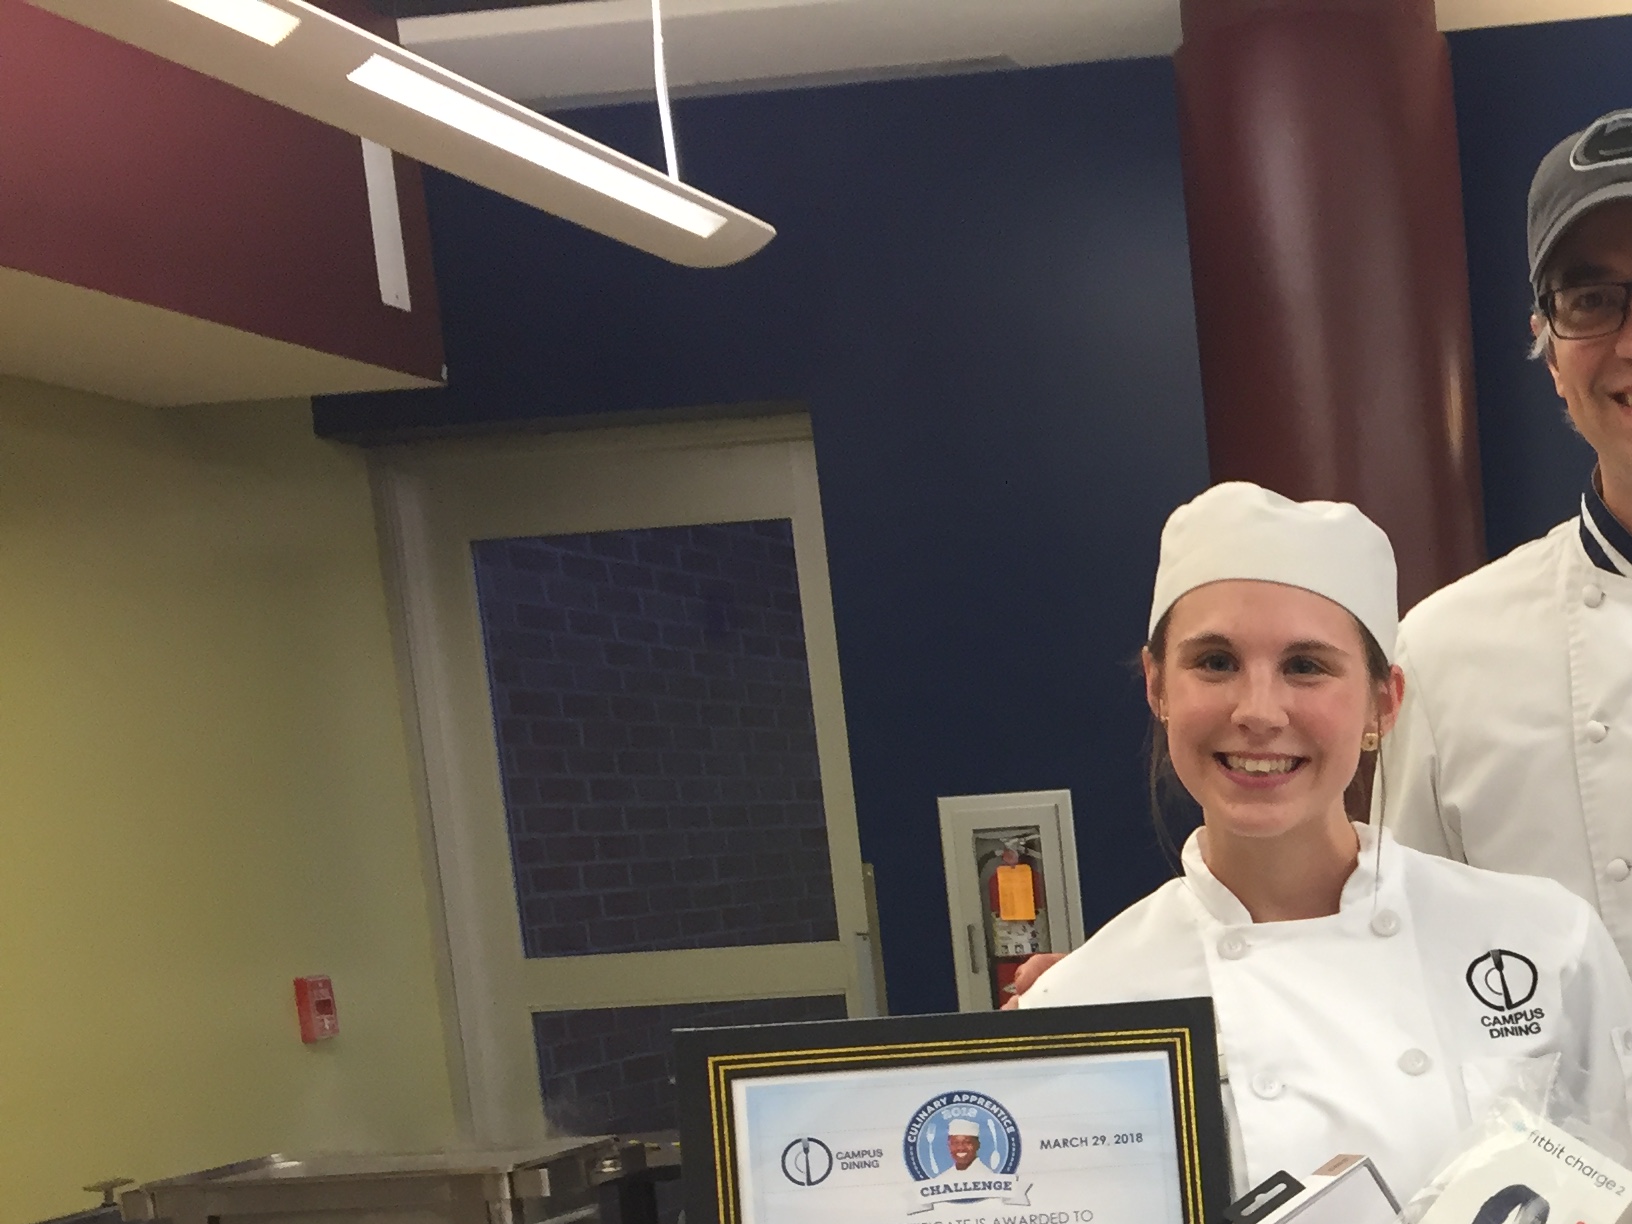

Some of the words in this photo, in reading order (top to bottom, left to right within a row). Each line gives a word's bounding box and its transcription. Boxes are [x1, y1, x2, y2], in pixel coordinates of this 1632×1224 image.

[1480, 1007, 1545, 1028] CAMPUS
[1489, 1021, 1542, 1039] DINING
[907, 1096, 948, 1143] CULINARY
[953, 1094, 1015, 1134] APPRENTICE
[941, 1107, 978, 1120] 2018
[1039, 1136, 1089, 1150] MARCH
[1114, 1132, 1143, 1145] 2018
[835, 1148, 883, 1160] CAMPUS
[1527, 1129, 1566, 1159] fitbit
[1564, 1155, 1617, 1191] charge
[1615, 1185, 1626, 1196] 2
[840, 1160, 880, 1170] DINING
[920, 1181, 1012, 1197] CHALLENGE
[1073, 1209, 1094, 1223] TO
